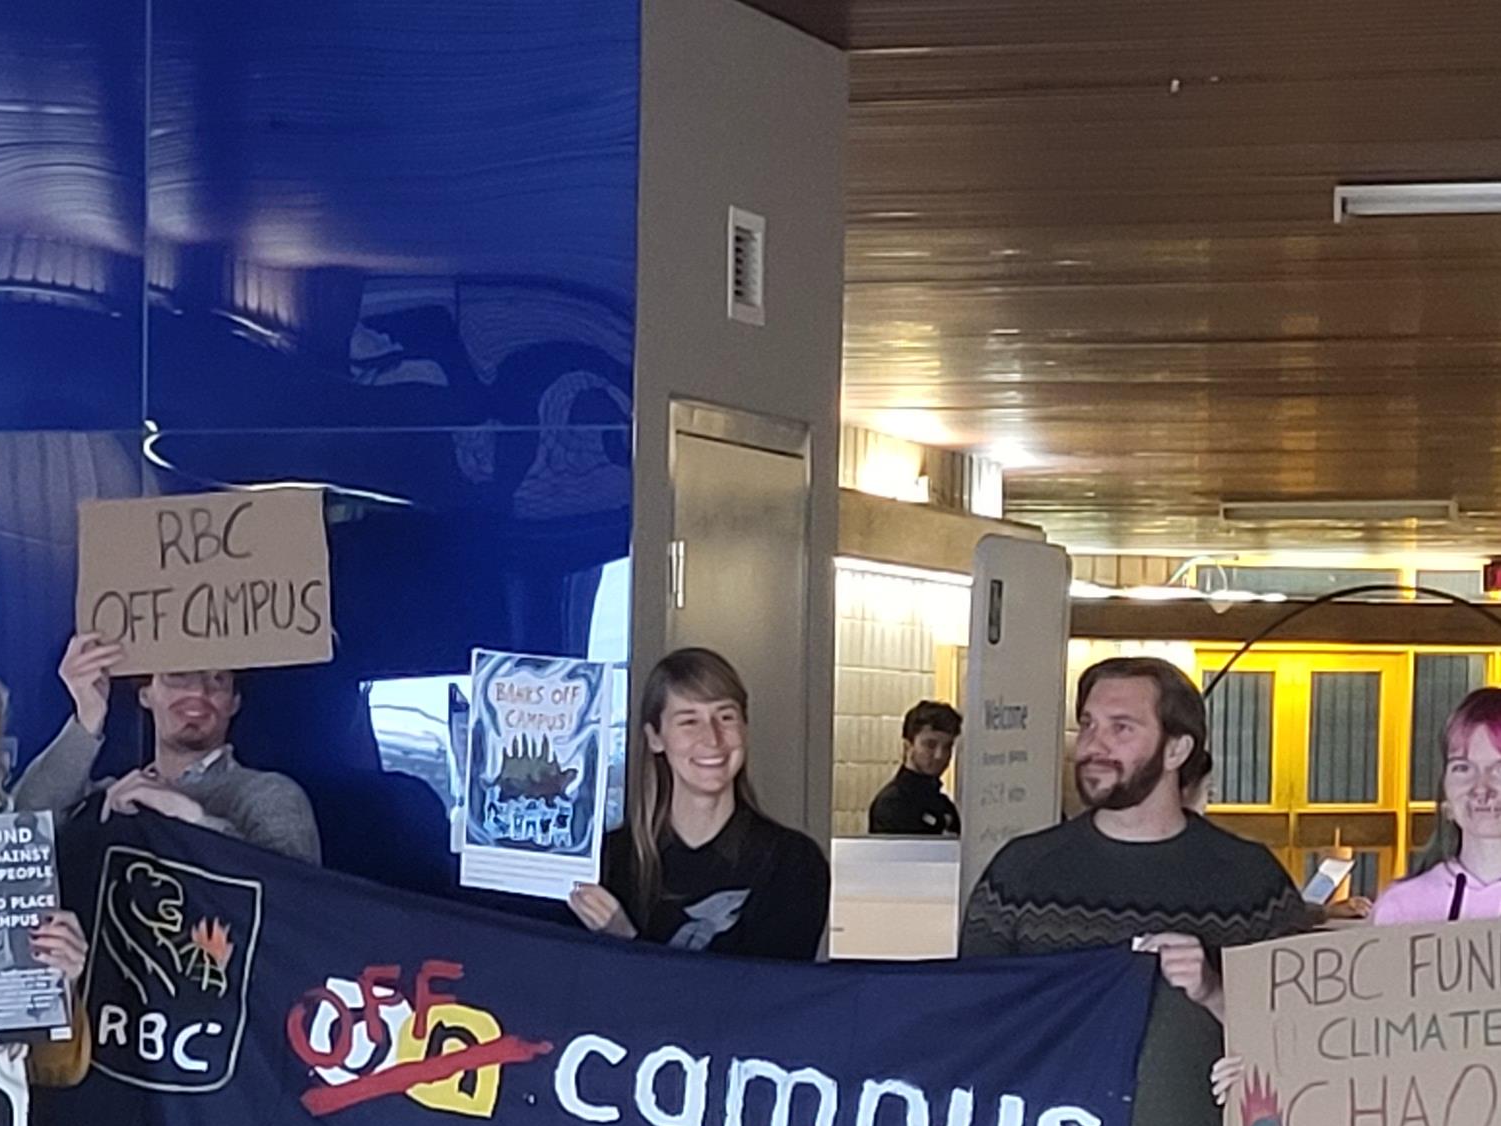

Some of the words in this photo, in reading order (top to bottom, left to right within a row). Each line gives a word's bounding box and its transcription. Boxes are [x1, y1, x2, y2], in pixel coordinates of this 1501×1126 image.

[157, 501, 253, 571] RBC
[92, 585, 175, 647] OFF
[181, 579, 324, 639] CAMPUS
[495, 681, 545, 705] BANKS
[551, 685, 581, 706] OFF
[11, 893, 56, 909] PLACE
[1269, 938, 1384, 1012] RBC
[1409, 930, 1501, 998] FUN
[97, 1003, 224, 1073] RBC
[1318, 1008, 1501, 1060] CLIMATE
